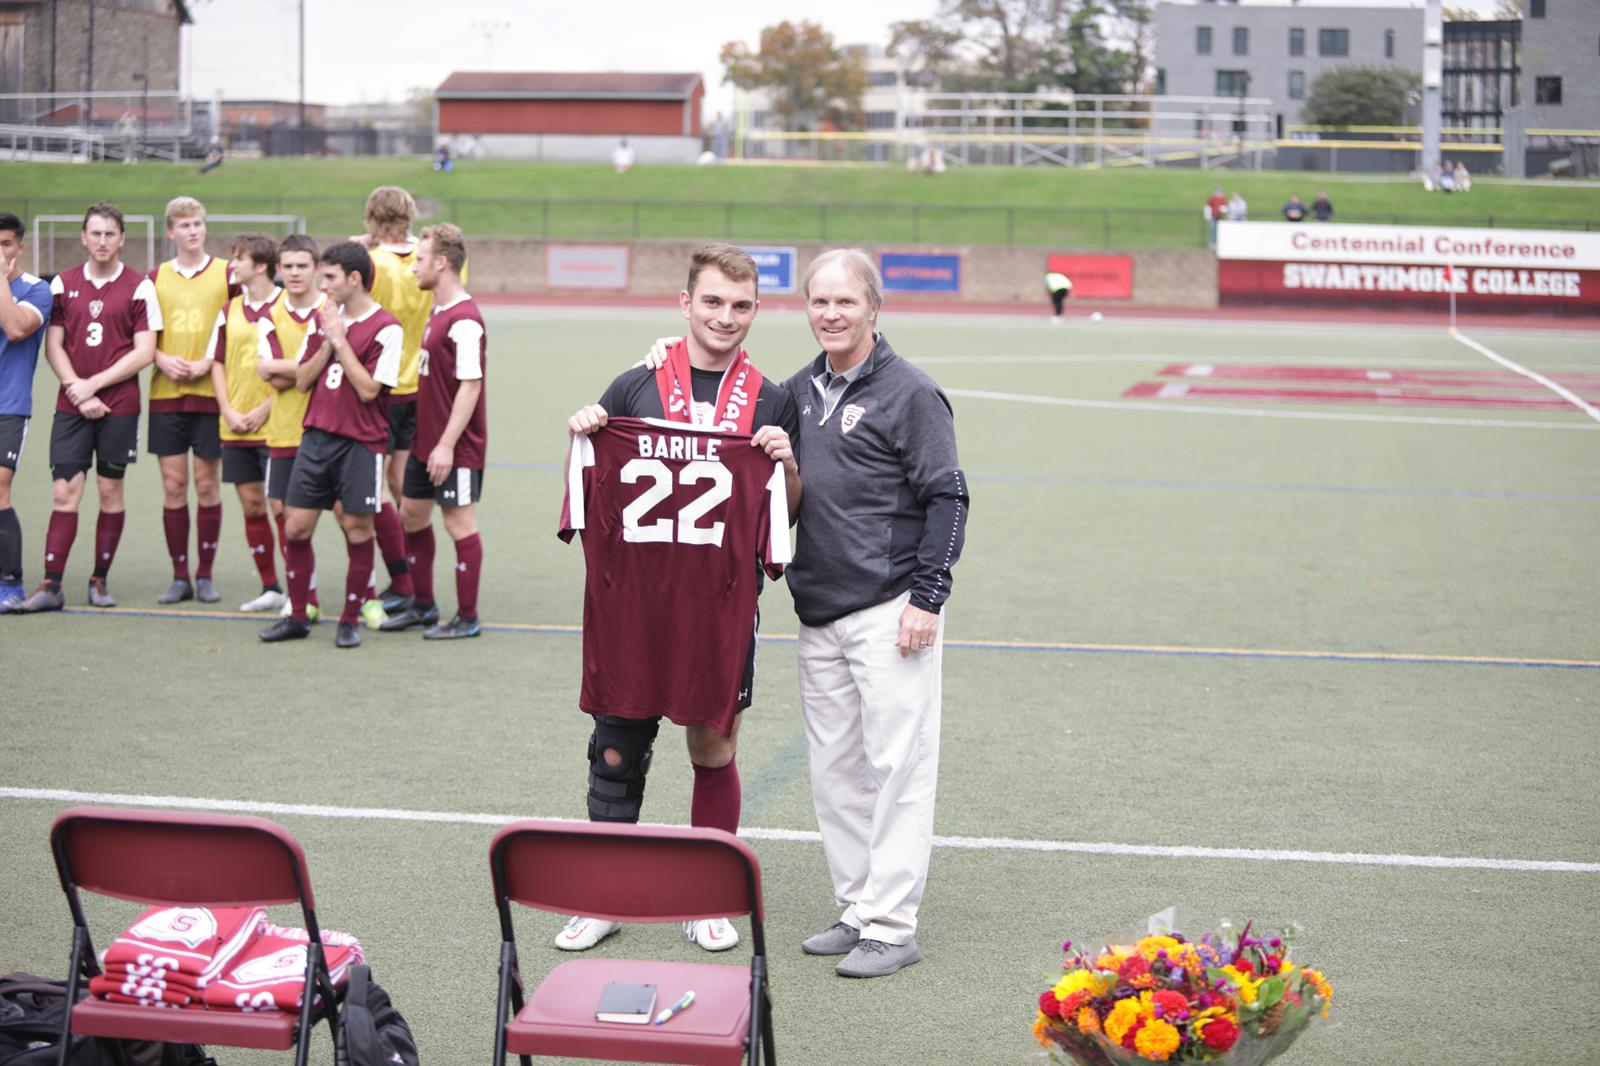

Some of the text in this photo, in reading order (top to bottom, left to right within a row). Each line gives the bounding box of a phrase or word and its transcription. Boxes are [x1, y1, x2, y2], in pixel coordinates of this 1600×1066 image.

[1291, 232, 1576, 259] Centennial Conference
[1473, 269, 1581, 297] COLLEGE
[85, 321, 104, 347] 3
[325, 362, 345, 389] 8
[637, 434, 722, 462] BARILE
[619, 458, 733, 547] 22
[168, 912, 200, 934] S
